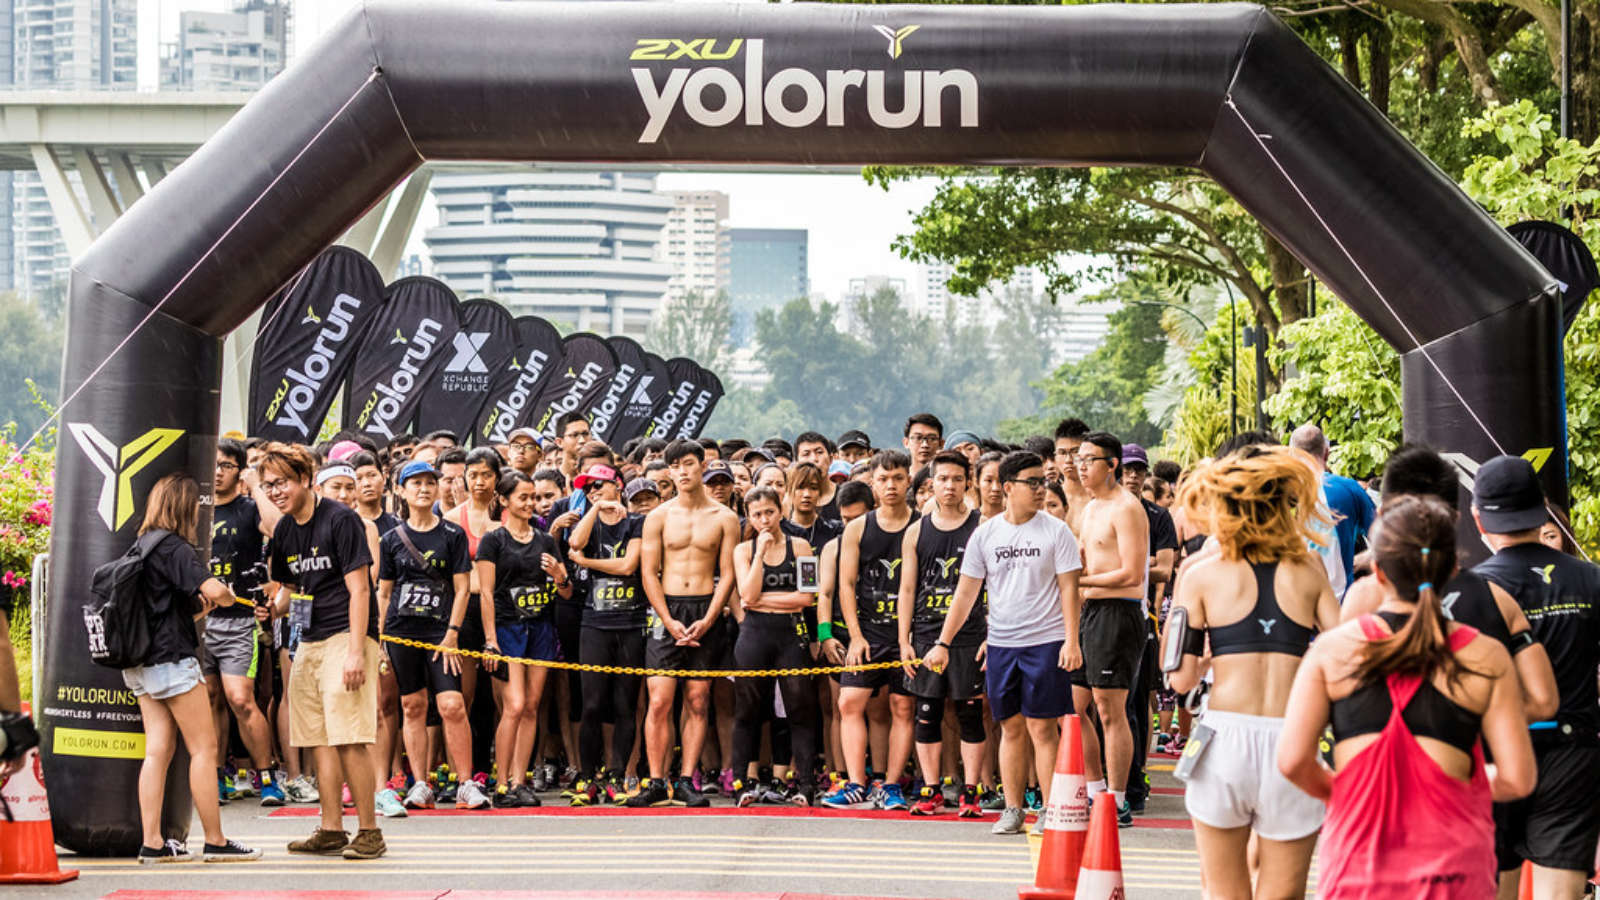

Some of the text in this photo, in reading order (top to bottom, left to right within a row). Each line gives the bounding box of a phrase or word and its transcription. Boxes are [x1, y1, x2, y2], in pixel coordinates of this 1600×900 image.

[629, 38, 744, 61] 2XU
[631, 38, 980, 144] yolorun
[276, 293, 362, 438] yolorun
[365, 318, 443, 441] yolorun
[442, 383, 489, 392] REPUBLIC
[443, 375, 489, 384] XCHANGE
[489, 349, 549, 444] yolorun
[651, 380, 695, 439] olorun
[995, 545, 1041, 563] yolorun
[209, 563, 232, 576] 35
[401, 593, 440, 607] 7798
[517, 592, 549, 608] 6625
[596, 586, 635, 599] 6206
[57, 686, 139, 706] #YOLORUNS
